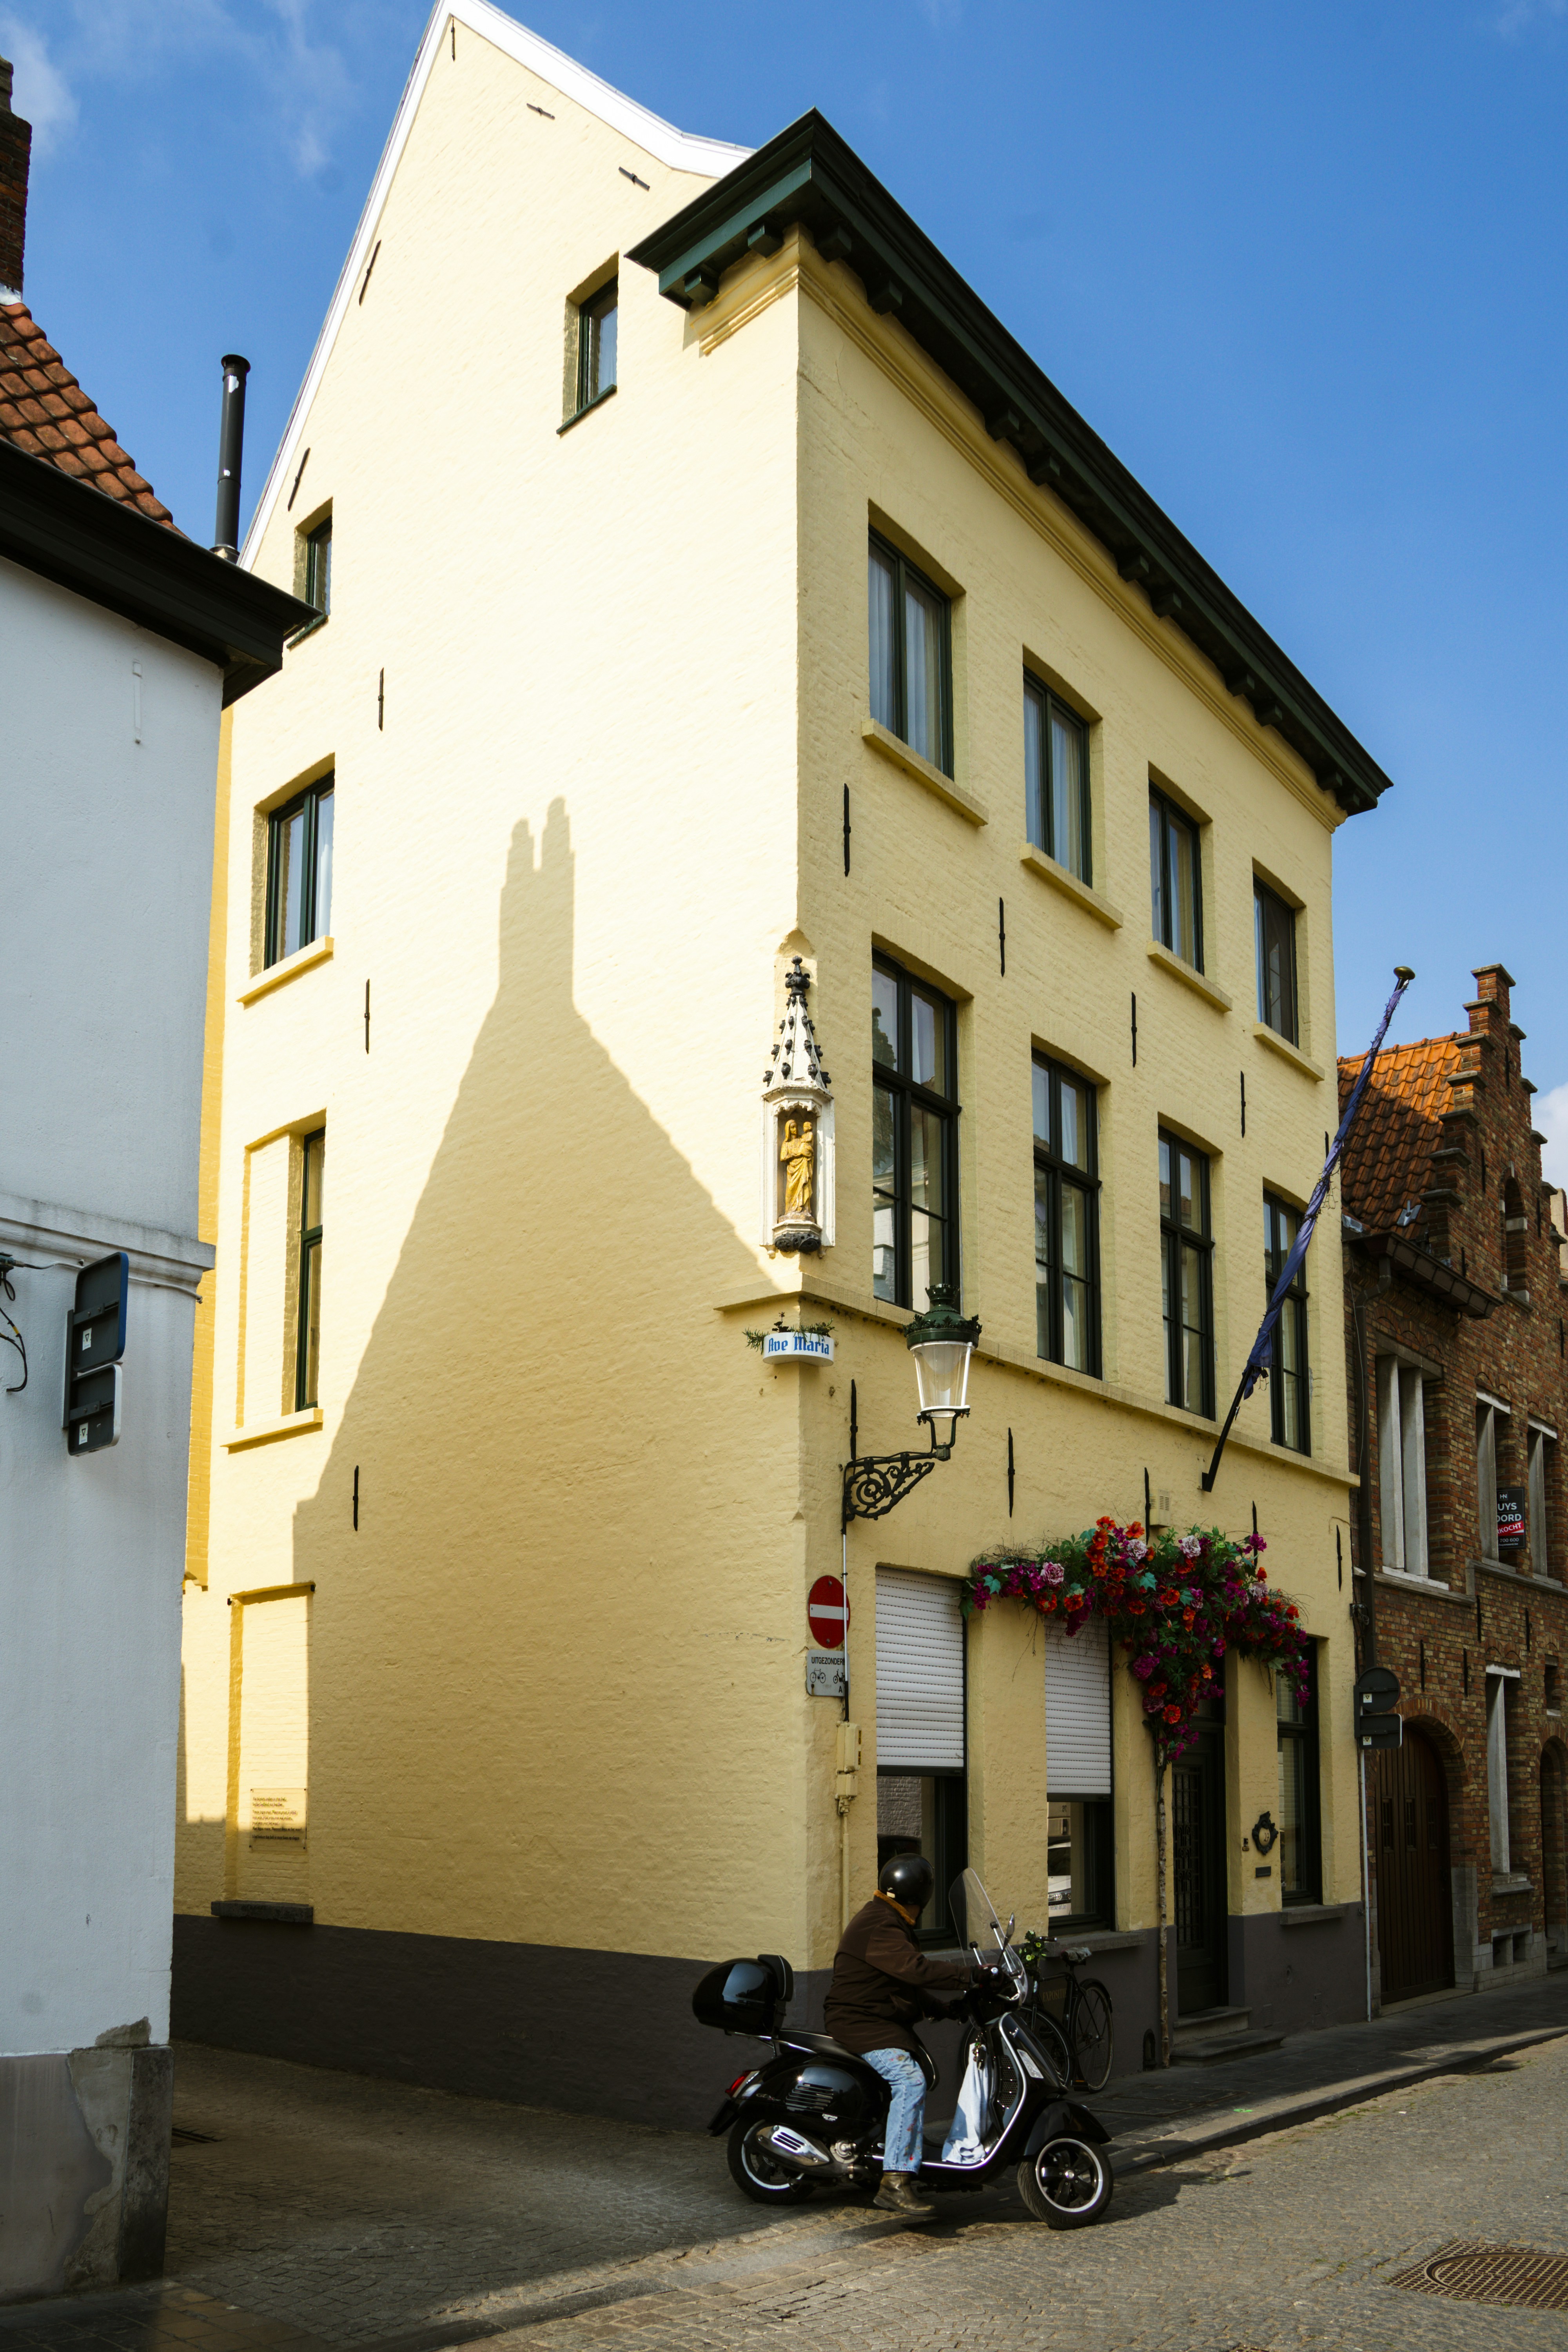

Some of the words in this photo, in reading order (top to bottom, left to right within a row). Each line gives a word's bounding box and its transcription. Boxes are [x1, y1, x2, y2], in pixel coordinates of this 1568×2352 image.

[768, 1337, 788, 1353] Ave
[794, 1336, 829, 1355] Maria
[1498, 1502, 1517, 1511] UYS
